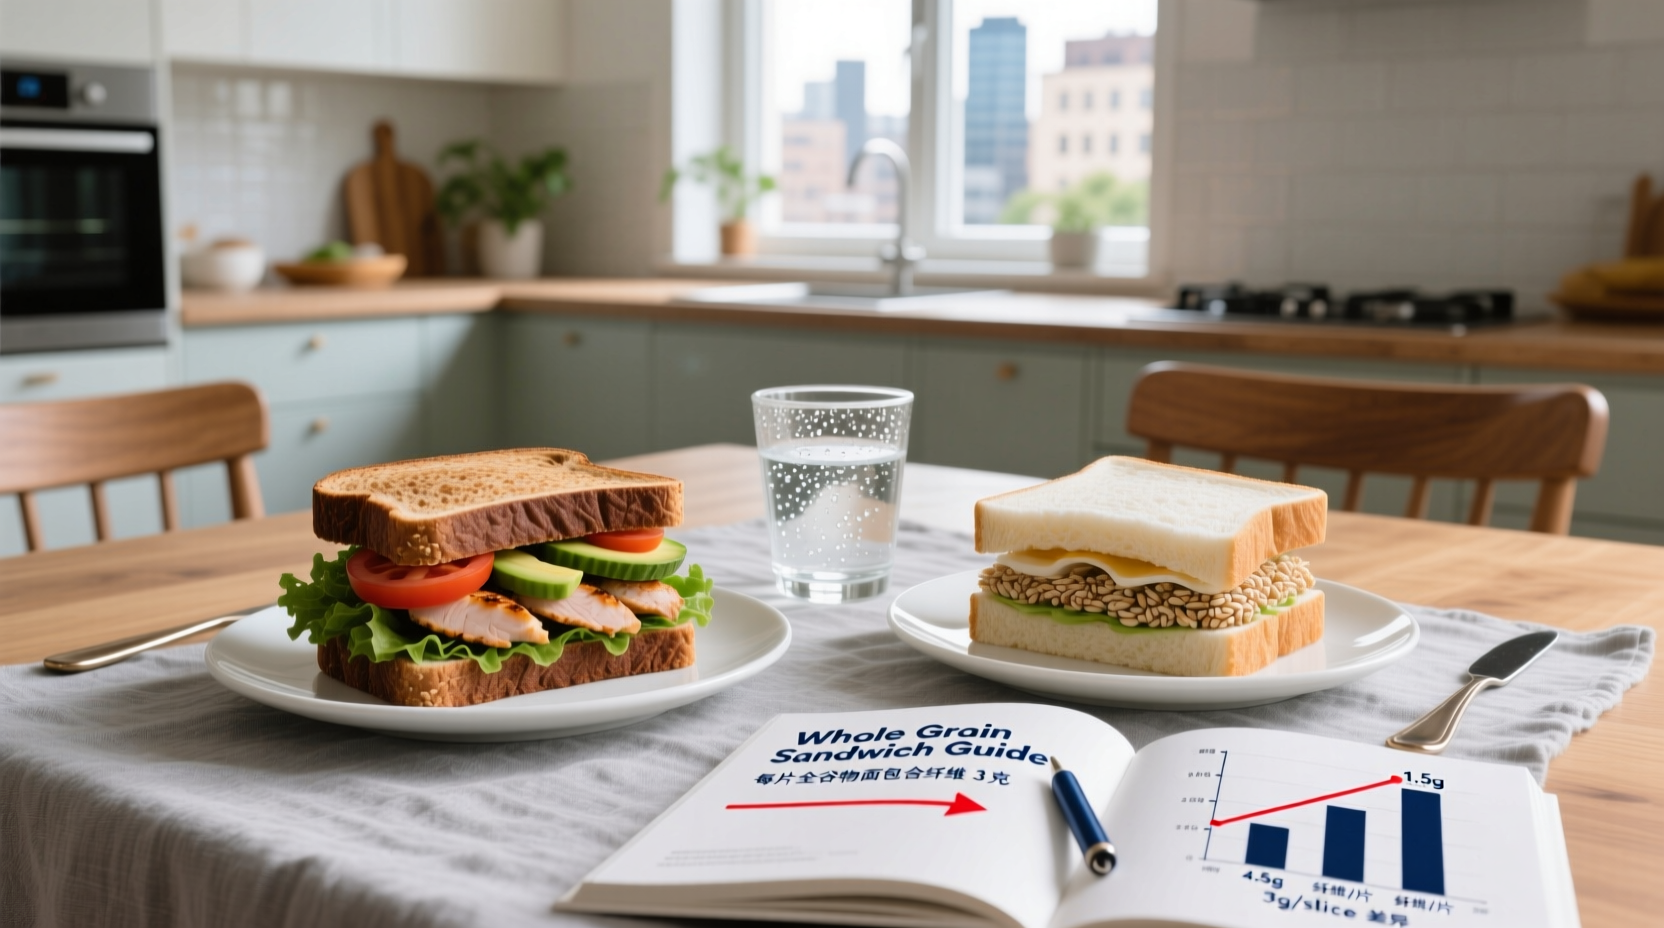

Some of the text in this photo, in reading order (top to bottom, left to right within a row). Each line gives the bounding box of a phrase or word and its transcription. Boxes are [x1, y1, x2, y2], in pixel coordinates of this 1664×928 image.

[797, 723, 1012, 746] Whole Grain
[770, 741, 1049, 766] Sandwich Guide
[973, 769, 986, 781] 3
[1403, 770, 1445, 790] 1.5g
[1243, 870, 1284, 889] 4.5g
[1263, 890, 1357, 918] 3g/slice
